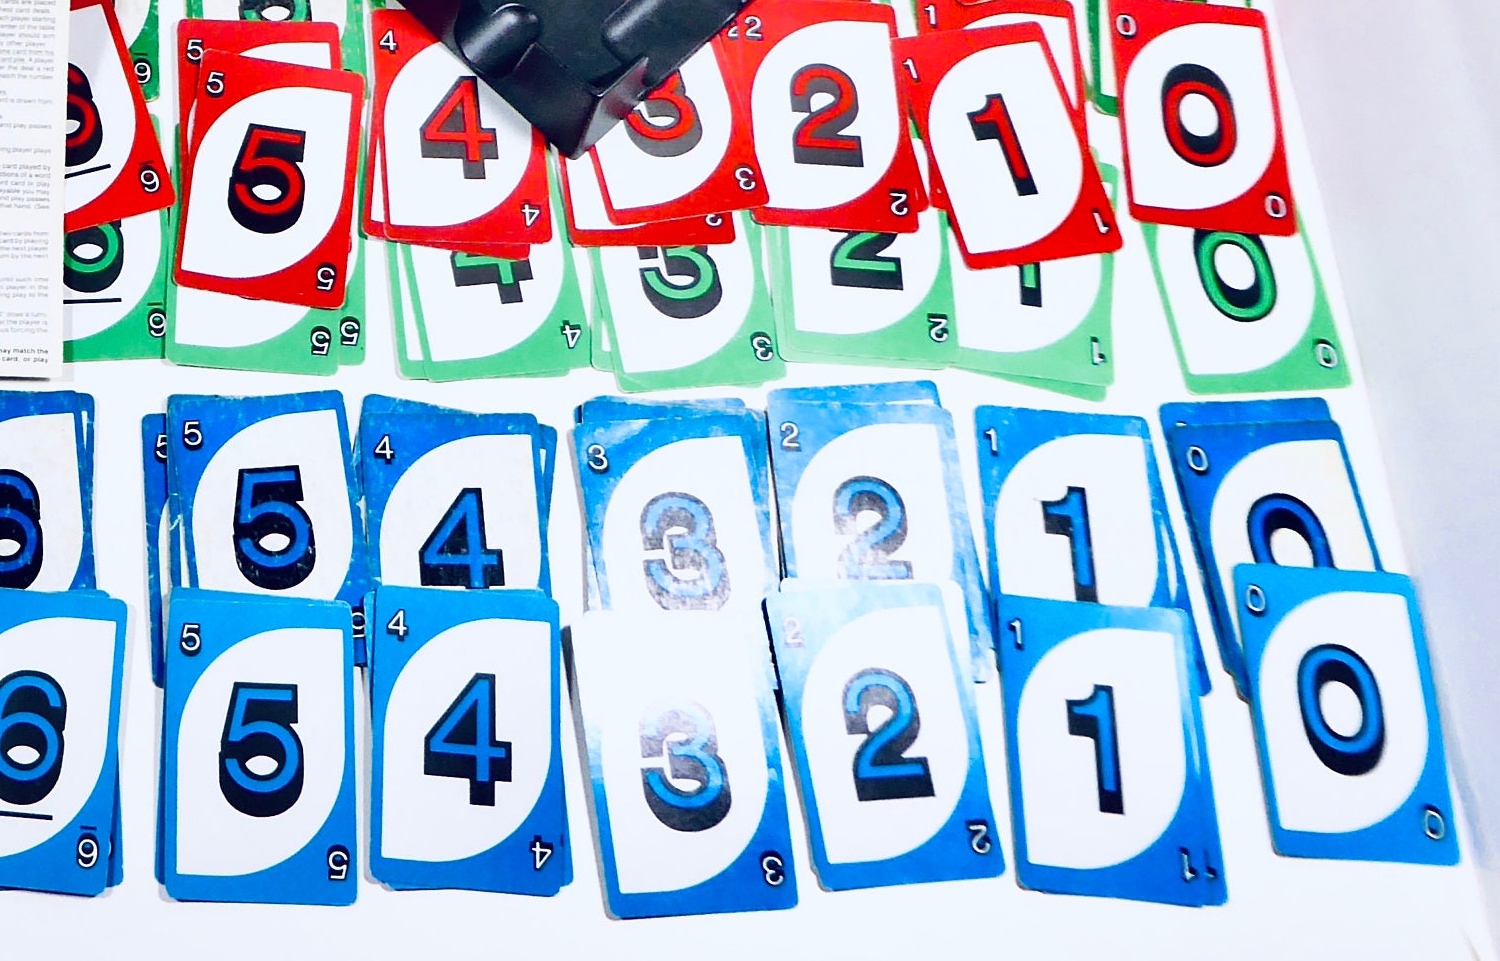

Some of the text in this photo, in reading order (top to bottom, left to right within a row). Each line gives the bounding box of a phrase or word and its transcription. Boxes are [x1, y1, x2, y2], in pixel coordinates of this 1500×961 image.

[419, 75, 499, 179] 4
[789, 62, 864, 168] 2
[966, 93, 1038, 196] 1
[1161, 63, 1236, 167] 0
[228, 122, 307, 234] 5
[1193, 229, 1277, 322] 0
[232, 465, 316, 591] 5
[419, 486, 505, 588] 4
[639, 491, 731, 611] 3
[832, 475, 913, 579] 2
[1034, 485, 1099, 604] 1
[180, 624, 201, 653] 5
[387, 611, 408, 638] 4
[1009, 619, 1023, 649] 1
[218, 682, 304, 818] 5
[423, 672, 512, 807] 4
[843, 667, 936, 802] 2
[1065, 683, 1126, 816] 1
[1297, 642, 1385, 777] 0
[638, 699, 732, 832] 3
